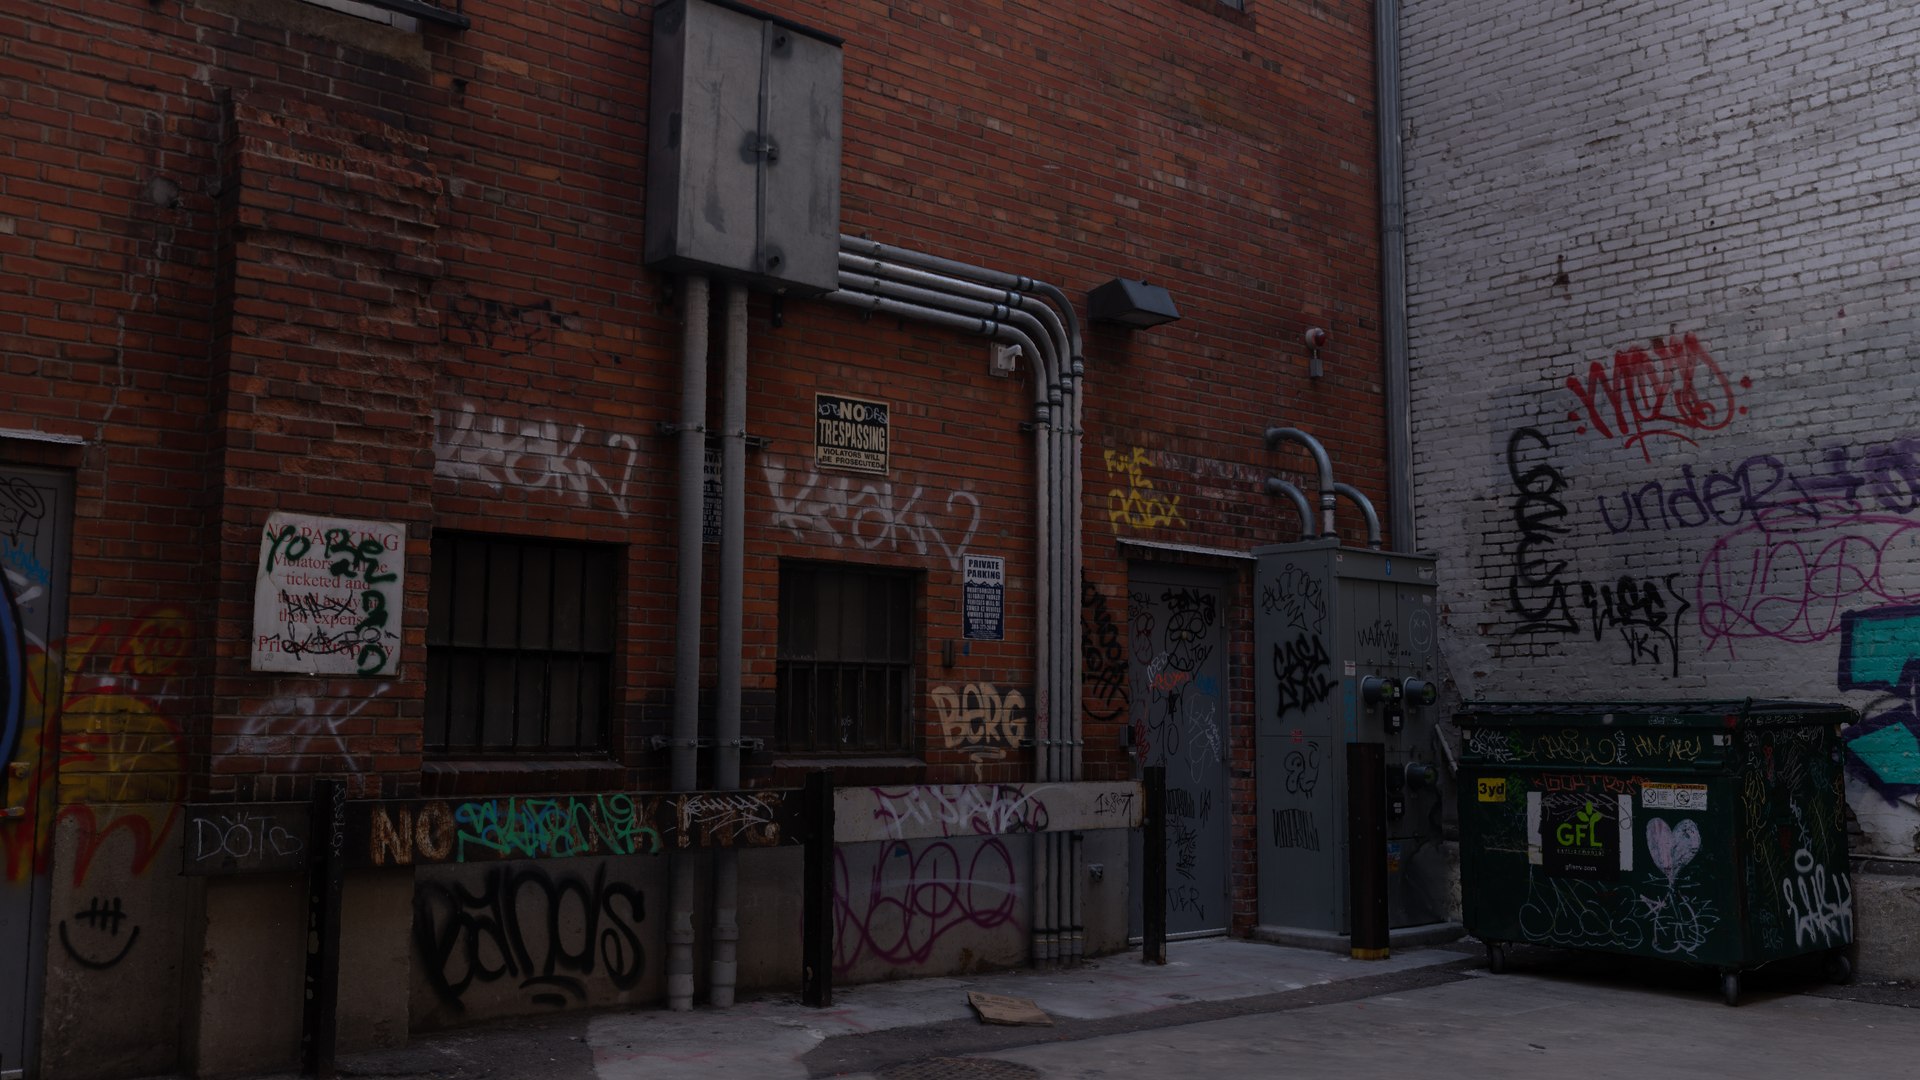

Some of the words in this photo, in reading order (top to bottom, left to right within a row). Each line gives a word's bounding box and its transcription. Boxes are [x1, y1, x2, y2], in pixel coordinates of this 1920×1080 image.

[840, 401, 866, 422] NO
[819, 418, 886, 452] TRESPASSING
[822, 455, 832, 463] BE
[835, 456, 880, 468] PROSECUTED
[823, 448, 862, 459] VIOLATORS
[864, 453, 880, 461] WILL
[968, 559, 1000, 570] PRIVATE
[286, 573, 341, 588] ticketed
[345, 576, 371, 590] and
[967, 569, 1000, 580] PARKING
[314, 614, 367, 628] expens
[1478, 782, 1505, 797] 3yd
[370, 800, 455, 865] NO
[1556, 819, 1604, 849] GFL
